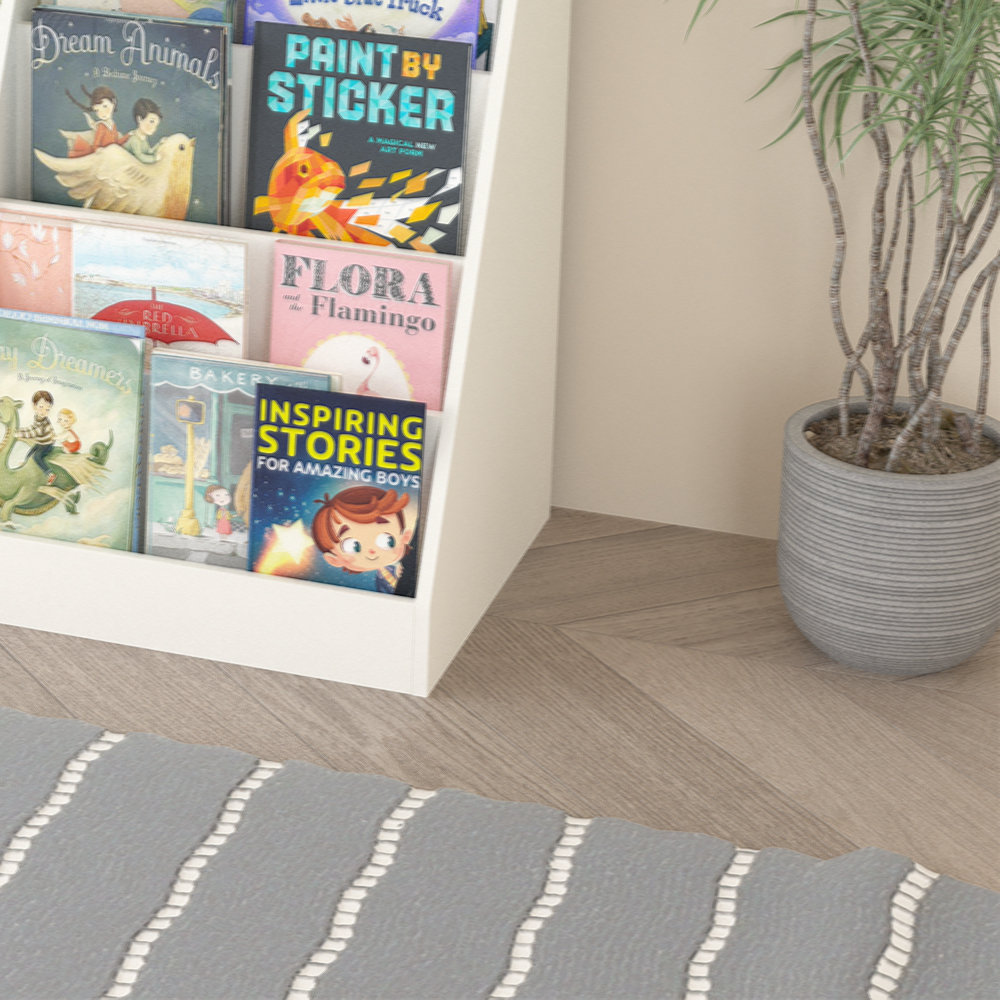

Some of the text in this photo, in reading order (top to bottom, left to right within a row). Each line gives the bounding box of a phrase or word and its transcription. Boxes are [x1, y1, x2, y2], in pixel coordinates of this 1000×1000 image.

[31, 19, 221, 90] Dream Animals
[285, 33, 442, 80] PAINT BY
[266, 70, 456, 132] STICKER
[280, 253, 442, 308] FLORA
[142, 310, 173, 324] RED
[311, 294, 437, 336] Flamingo
[27, 332, 132, 394] Dreamers
[189, 366, 280, 386] BAKERY
[259, 398, 424, 440] INSPIRING
[257, 424, 423, 472] STORIES
[257, 456, 421, 489] FOR AMAZING BOYS
